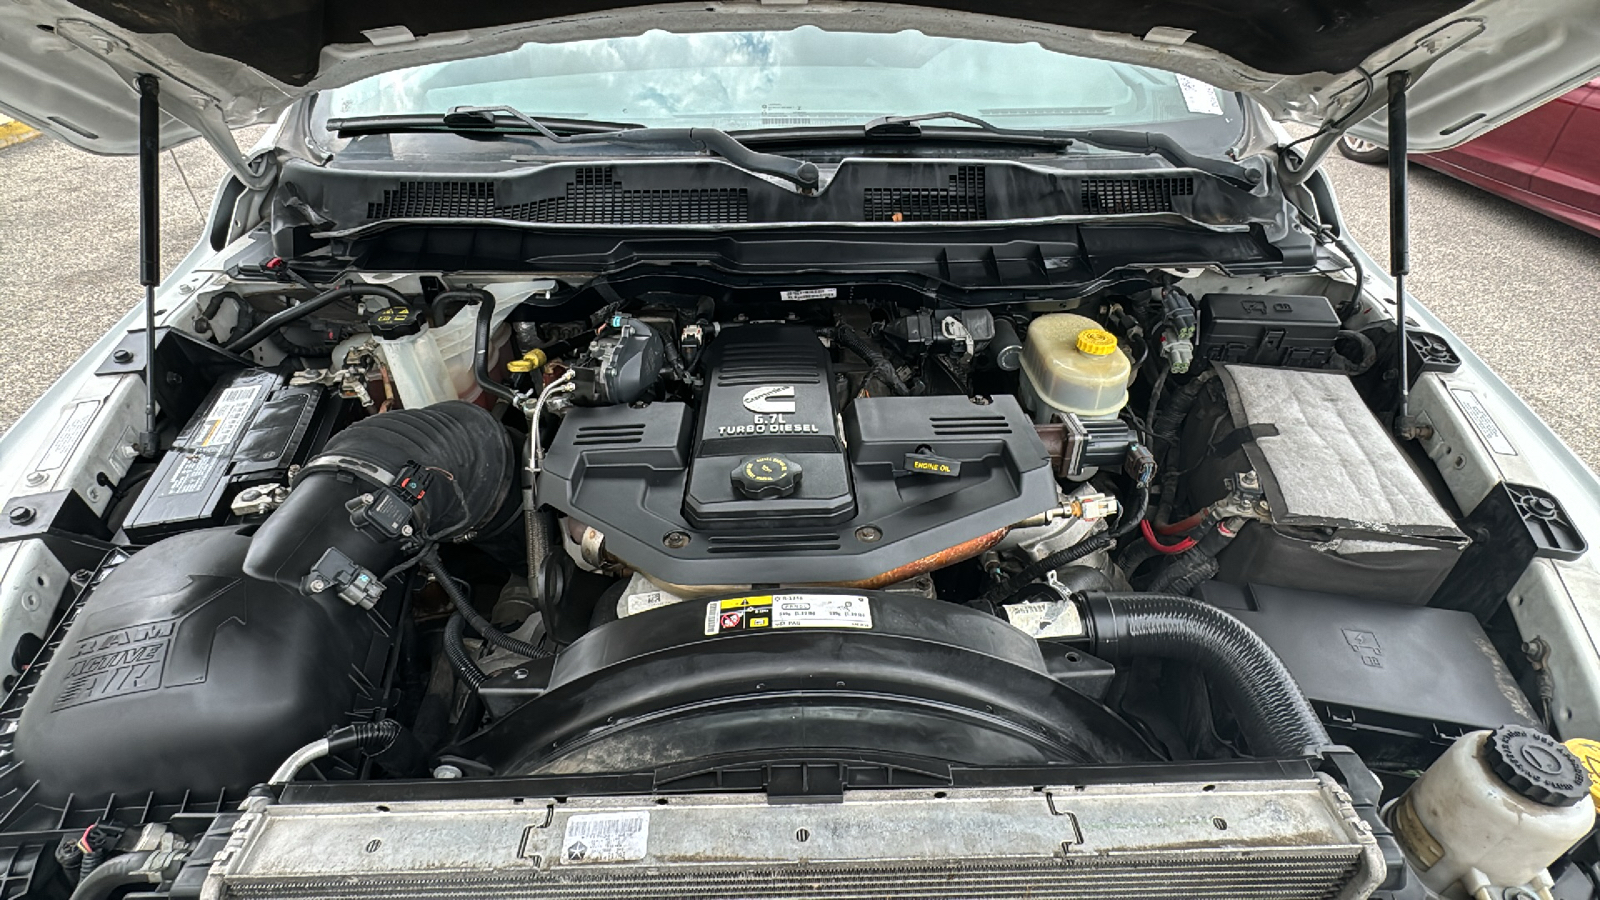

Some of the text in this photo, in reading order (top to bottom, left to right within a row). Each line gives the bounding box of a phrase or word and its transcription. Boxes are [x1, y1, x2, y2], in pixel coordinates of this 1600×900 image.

[754, 413, 786, 425] 6.7L
[718, 423, 819, 436] TURBO DIESEL
[914, 461, 951, 473] ENGINE OIL
[68, 621, 177, 660] RAM
